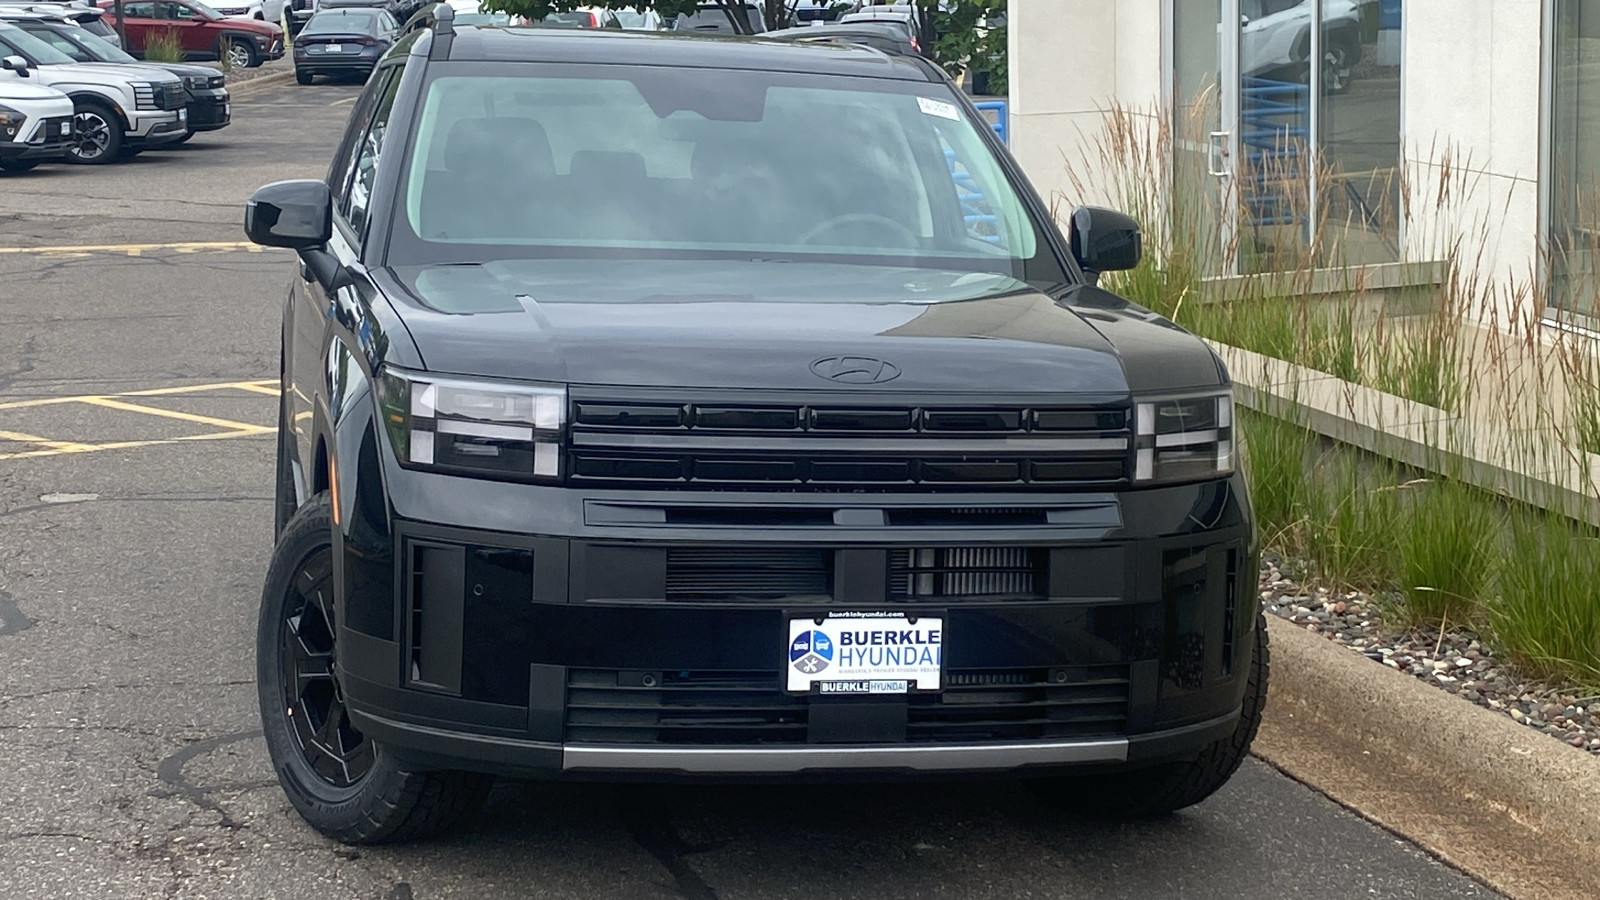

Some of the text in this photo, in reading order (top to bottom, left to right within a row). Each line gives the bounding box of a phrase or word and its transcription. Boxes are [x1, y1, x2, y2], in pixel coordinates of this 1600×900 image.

[840, 630, 941, 646] BUERKLE
[840, 646, 941, 666] HYUNDAI
[822, 681, 906, 692] BUERKLE HYUNDAI
